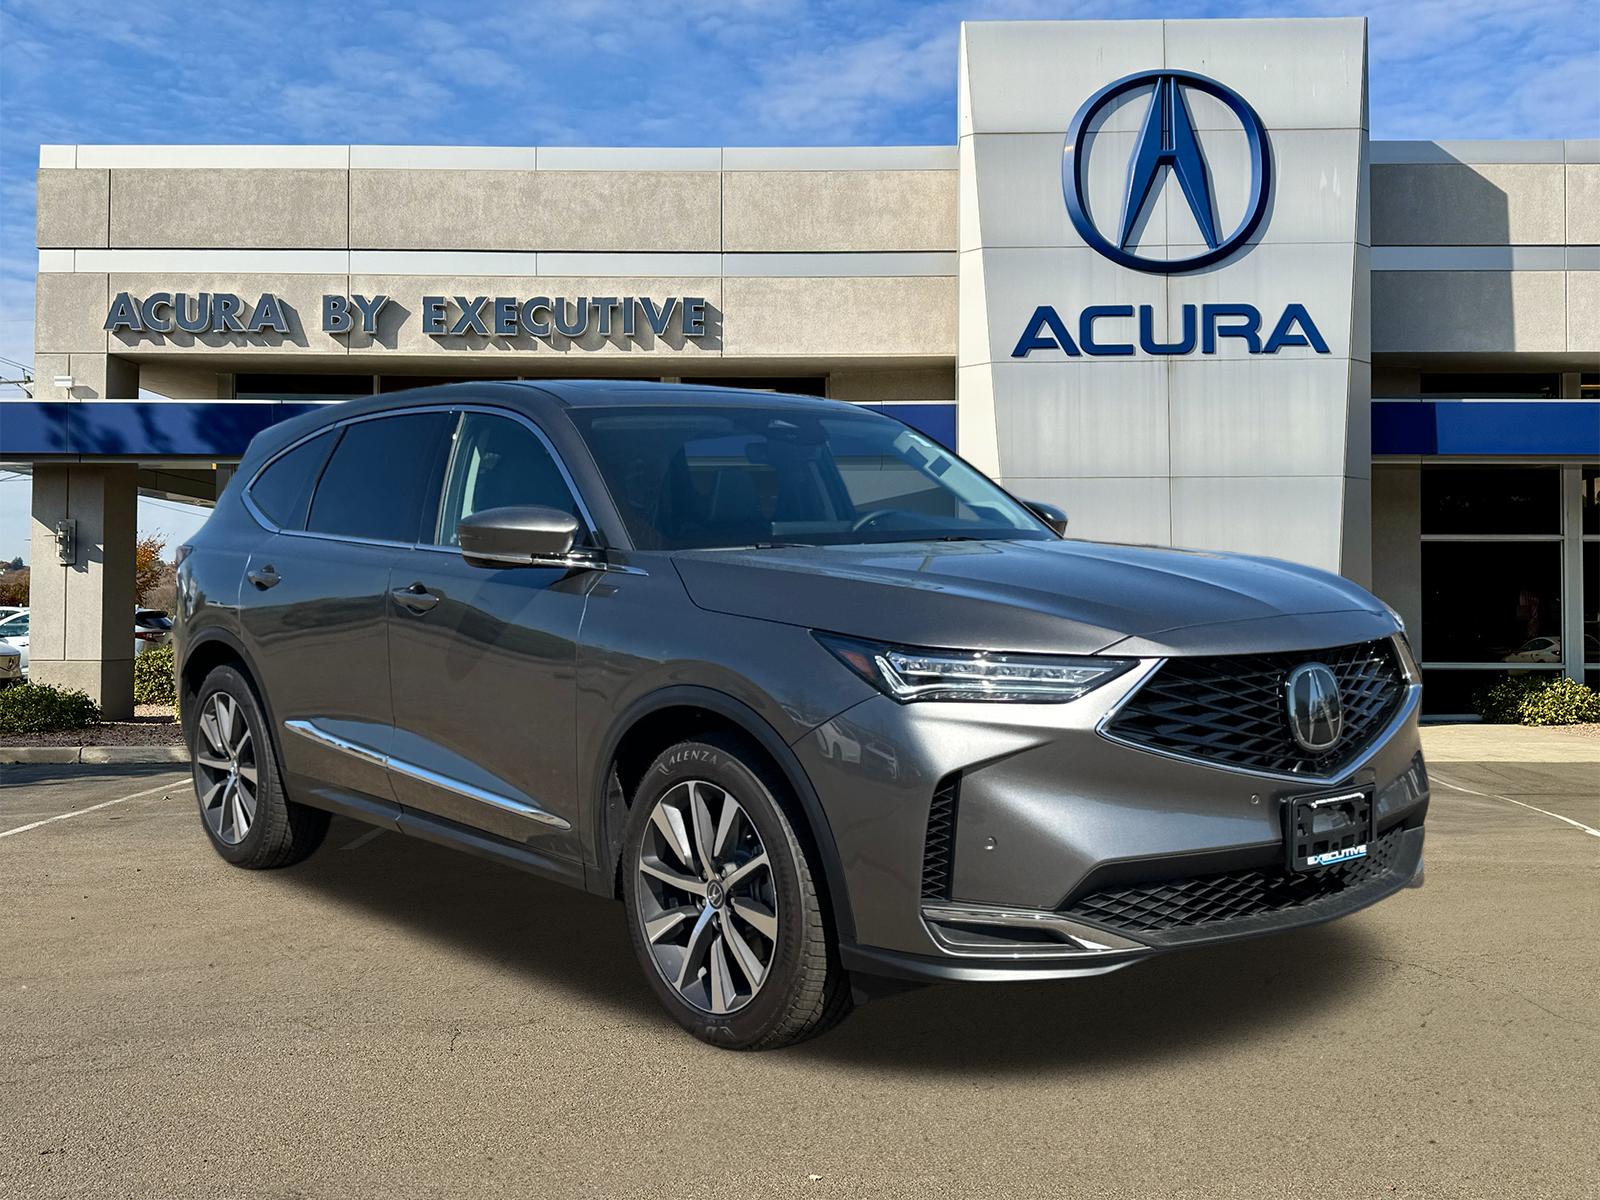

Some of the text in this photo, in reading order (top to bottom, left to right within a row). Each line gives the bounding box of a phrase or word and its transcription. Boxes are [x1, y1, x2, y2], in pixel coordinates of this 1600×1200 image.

[103, 292, 706, 337] ACURA BY EXECUTIVE
[1011, 303, 1332, 357] ACURA
[1307, 844, 1366, 865] EXECUTIVE
